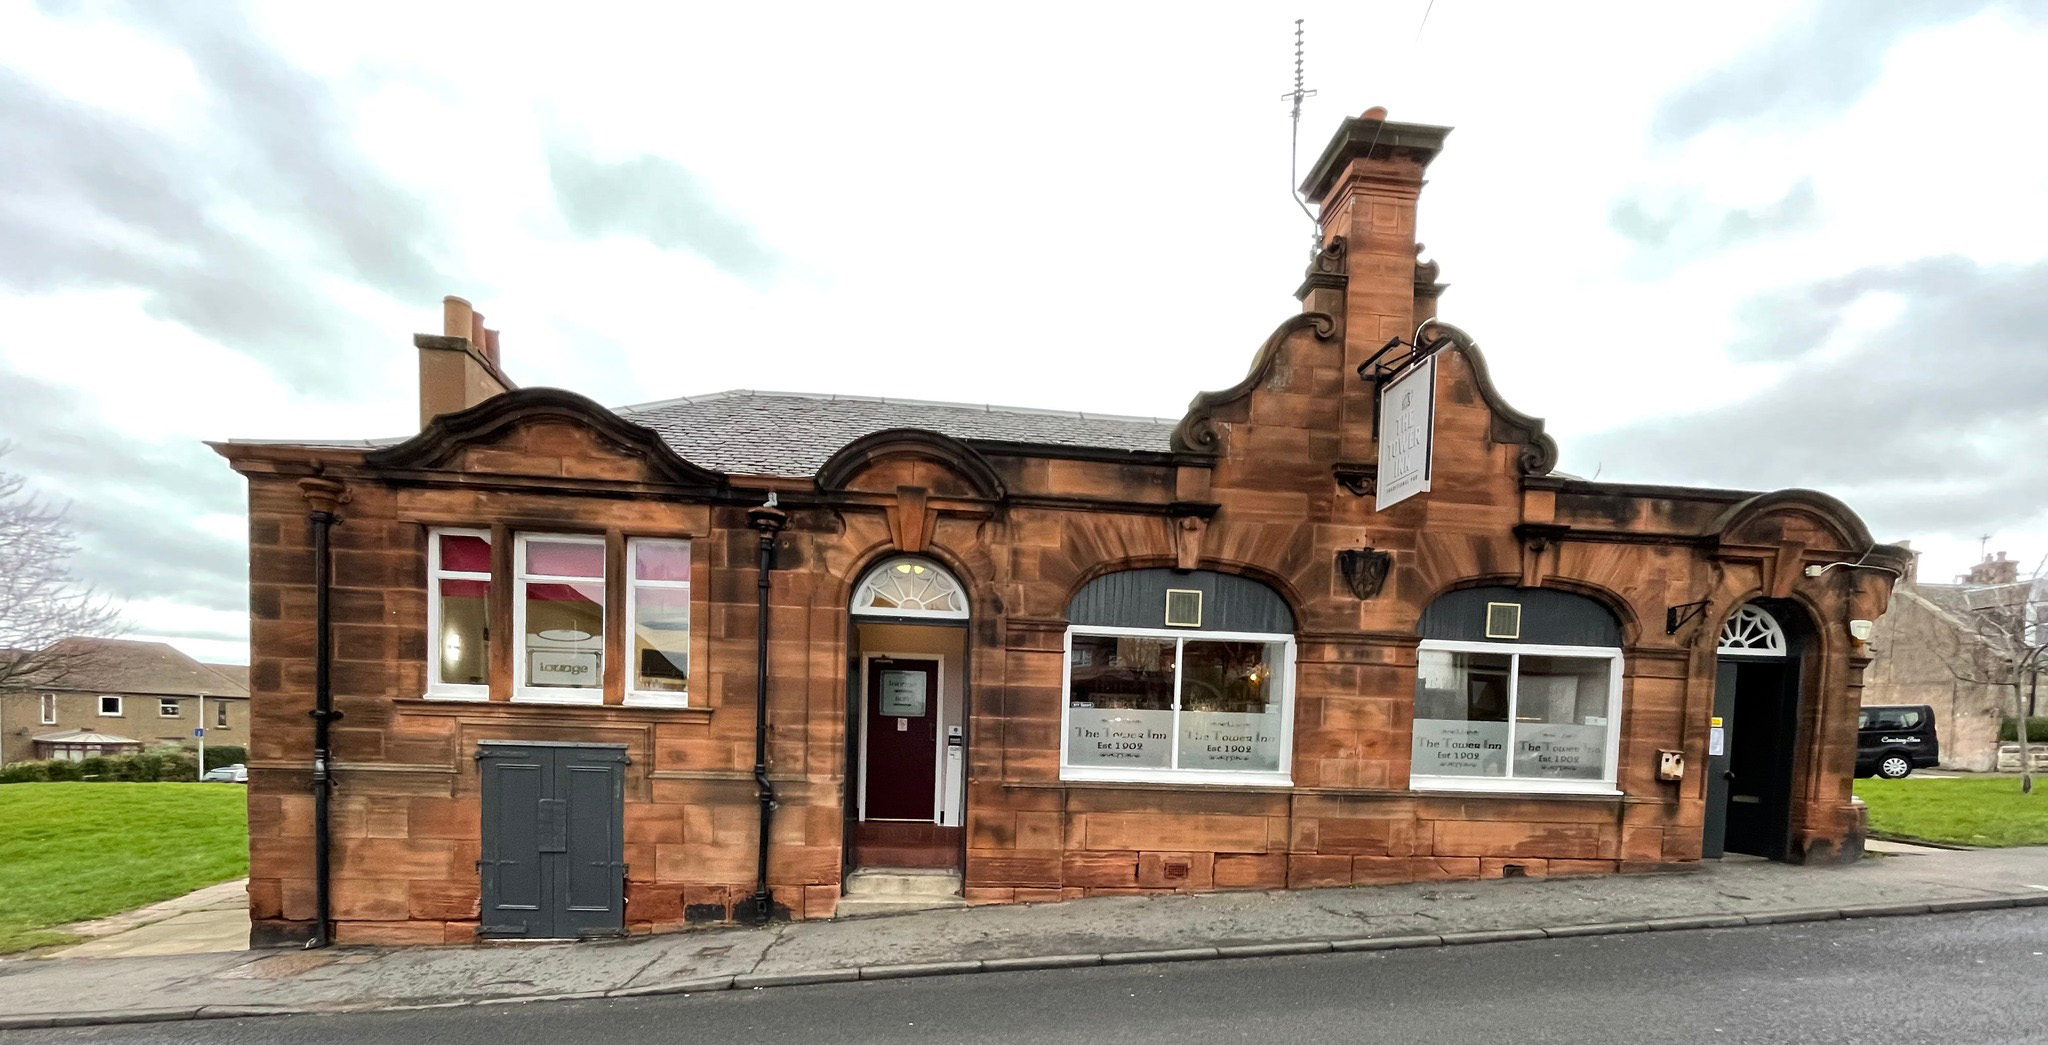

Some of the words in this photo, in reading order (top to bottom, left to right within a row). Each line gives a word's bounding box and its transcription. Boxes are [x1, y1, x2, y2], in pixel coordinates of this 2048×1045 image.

[1395, 410, 1414, 436] THE
[1388, 427, 1422, 462] TOWER
[1075, 727, 1100, 738] The
[1103, 727, 1144, 739] Tower
[1147, 729, 1167, 740] Inn
[1212, 731, 1253, 742] Tower
[1115, 742, 1144, 751] 1902
[1225, 745, 1252, 753] 1902
[1416, 736, 1440, 748] The
[1443, 738, 1481, 750] Tower
[1483, 739, 1503, 751] Inn
[1519, 740, 1542, 752] The
[1542, 742, 1580, 753] Tower
[1454, 752, 1480, 760] 1902
[1555, 755, 1580, 763] 1902
